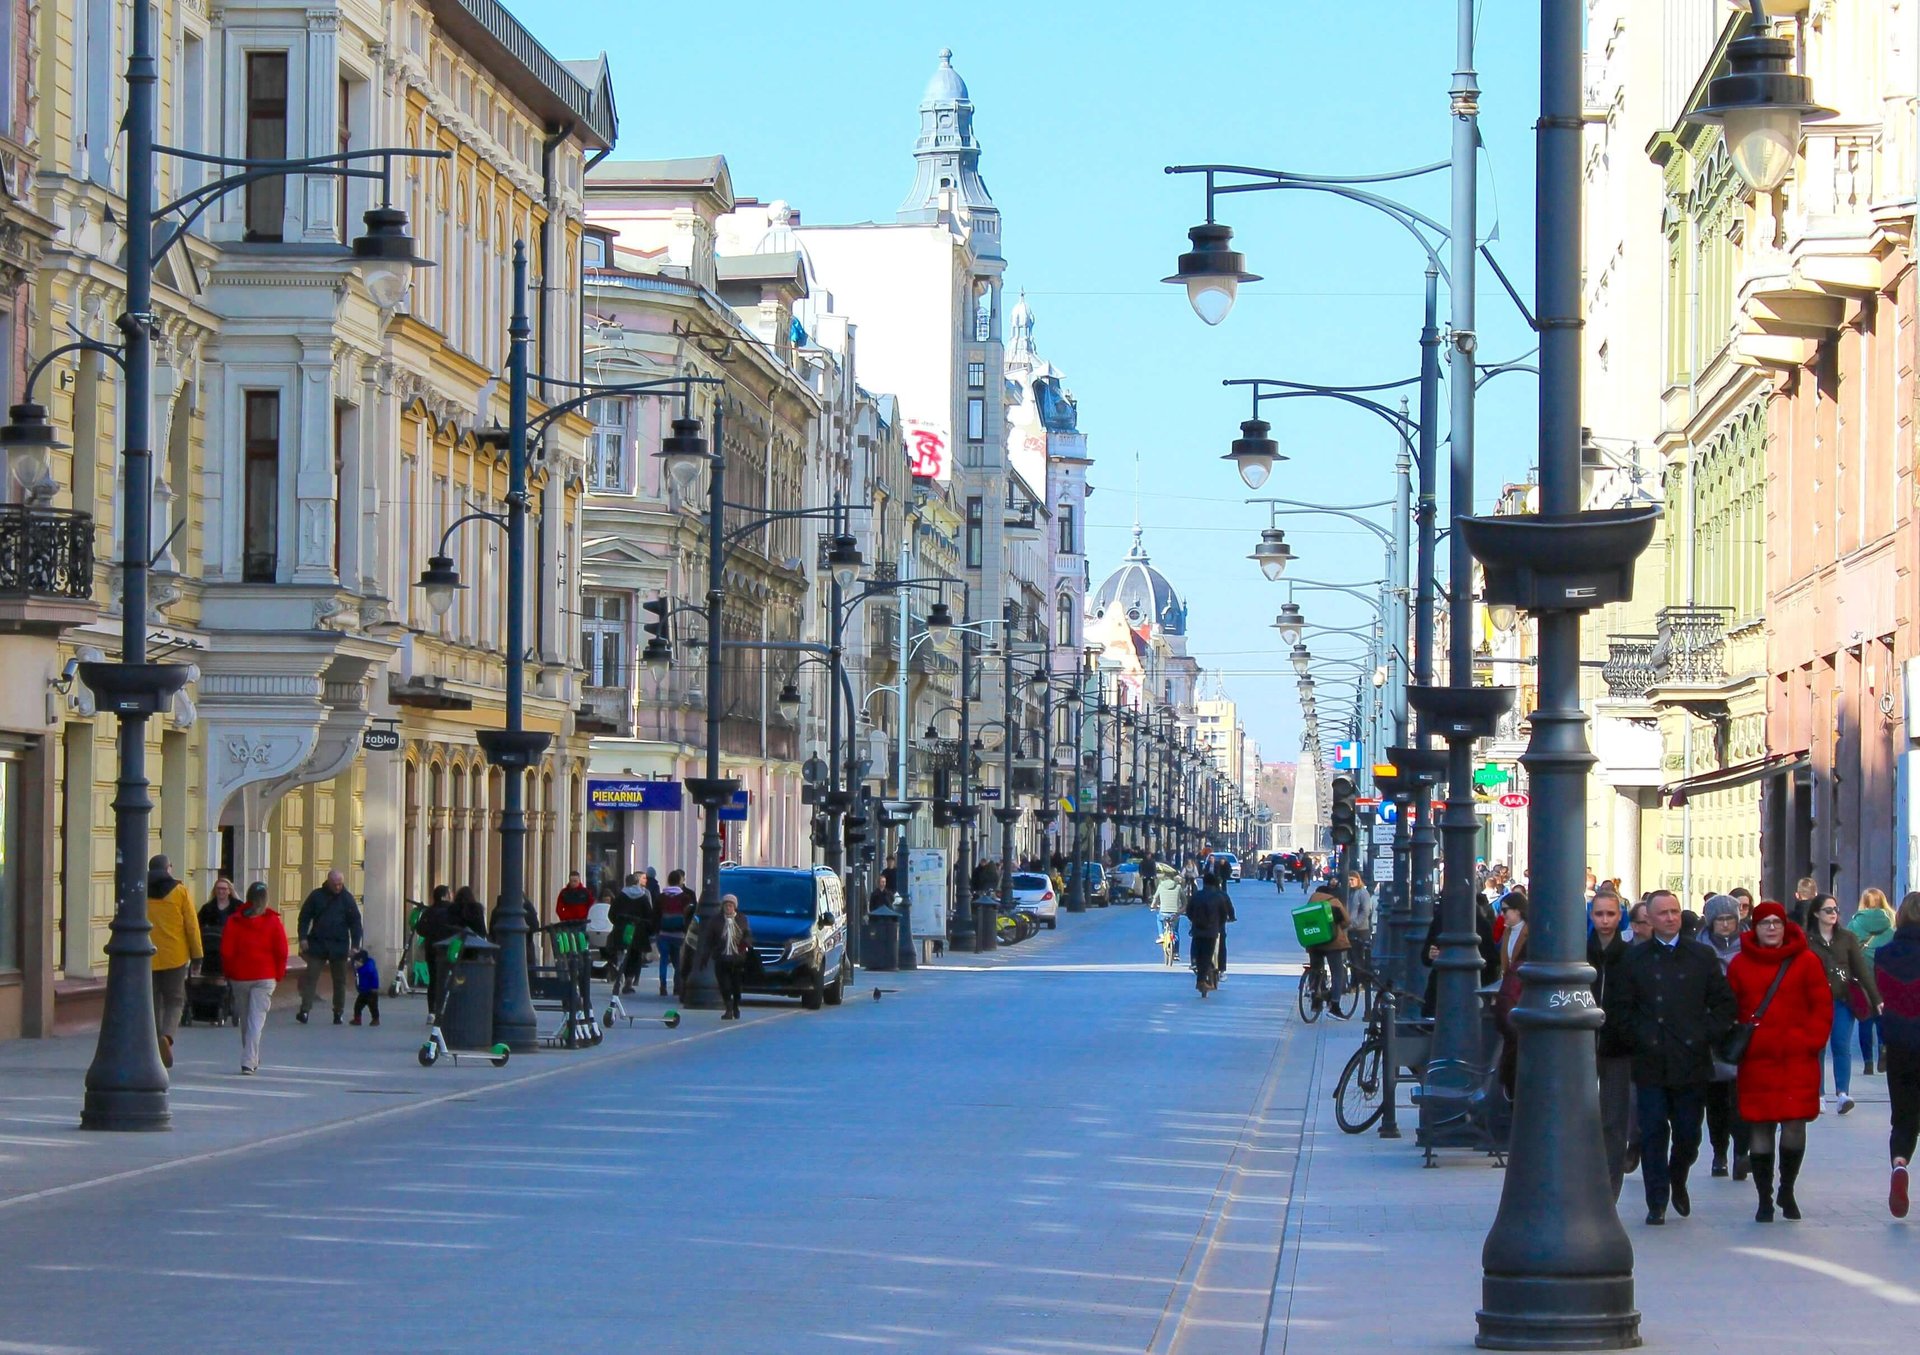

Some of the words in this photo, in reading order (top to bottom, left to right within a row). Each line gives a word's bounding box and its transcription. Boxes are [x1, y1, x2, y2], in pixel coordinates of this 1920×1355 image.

[365, 734, 396, 745] żabka
[592, 791, 643, 803] PIEKARNIA
[1503, 796, 1524, 805] A&A
[1303, 927, 1320, 935] Eats
